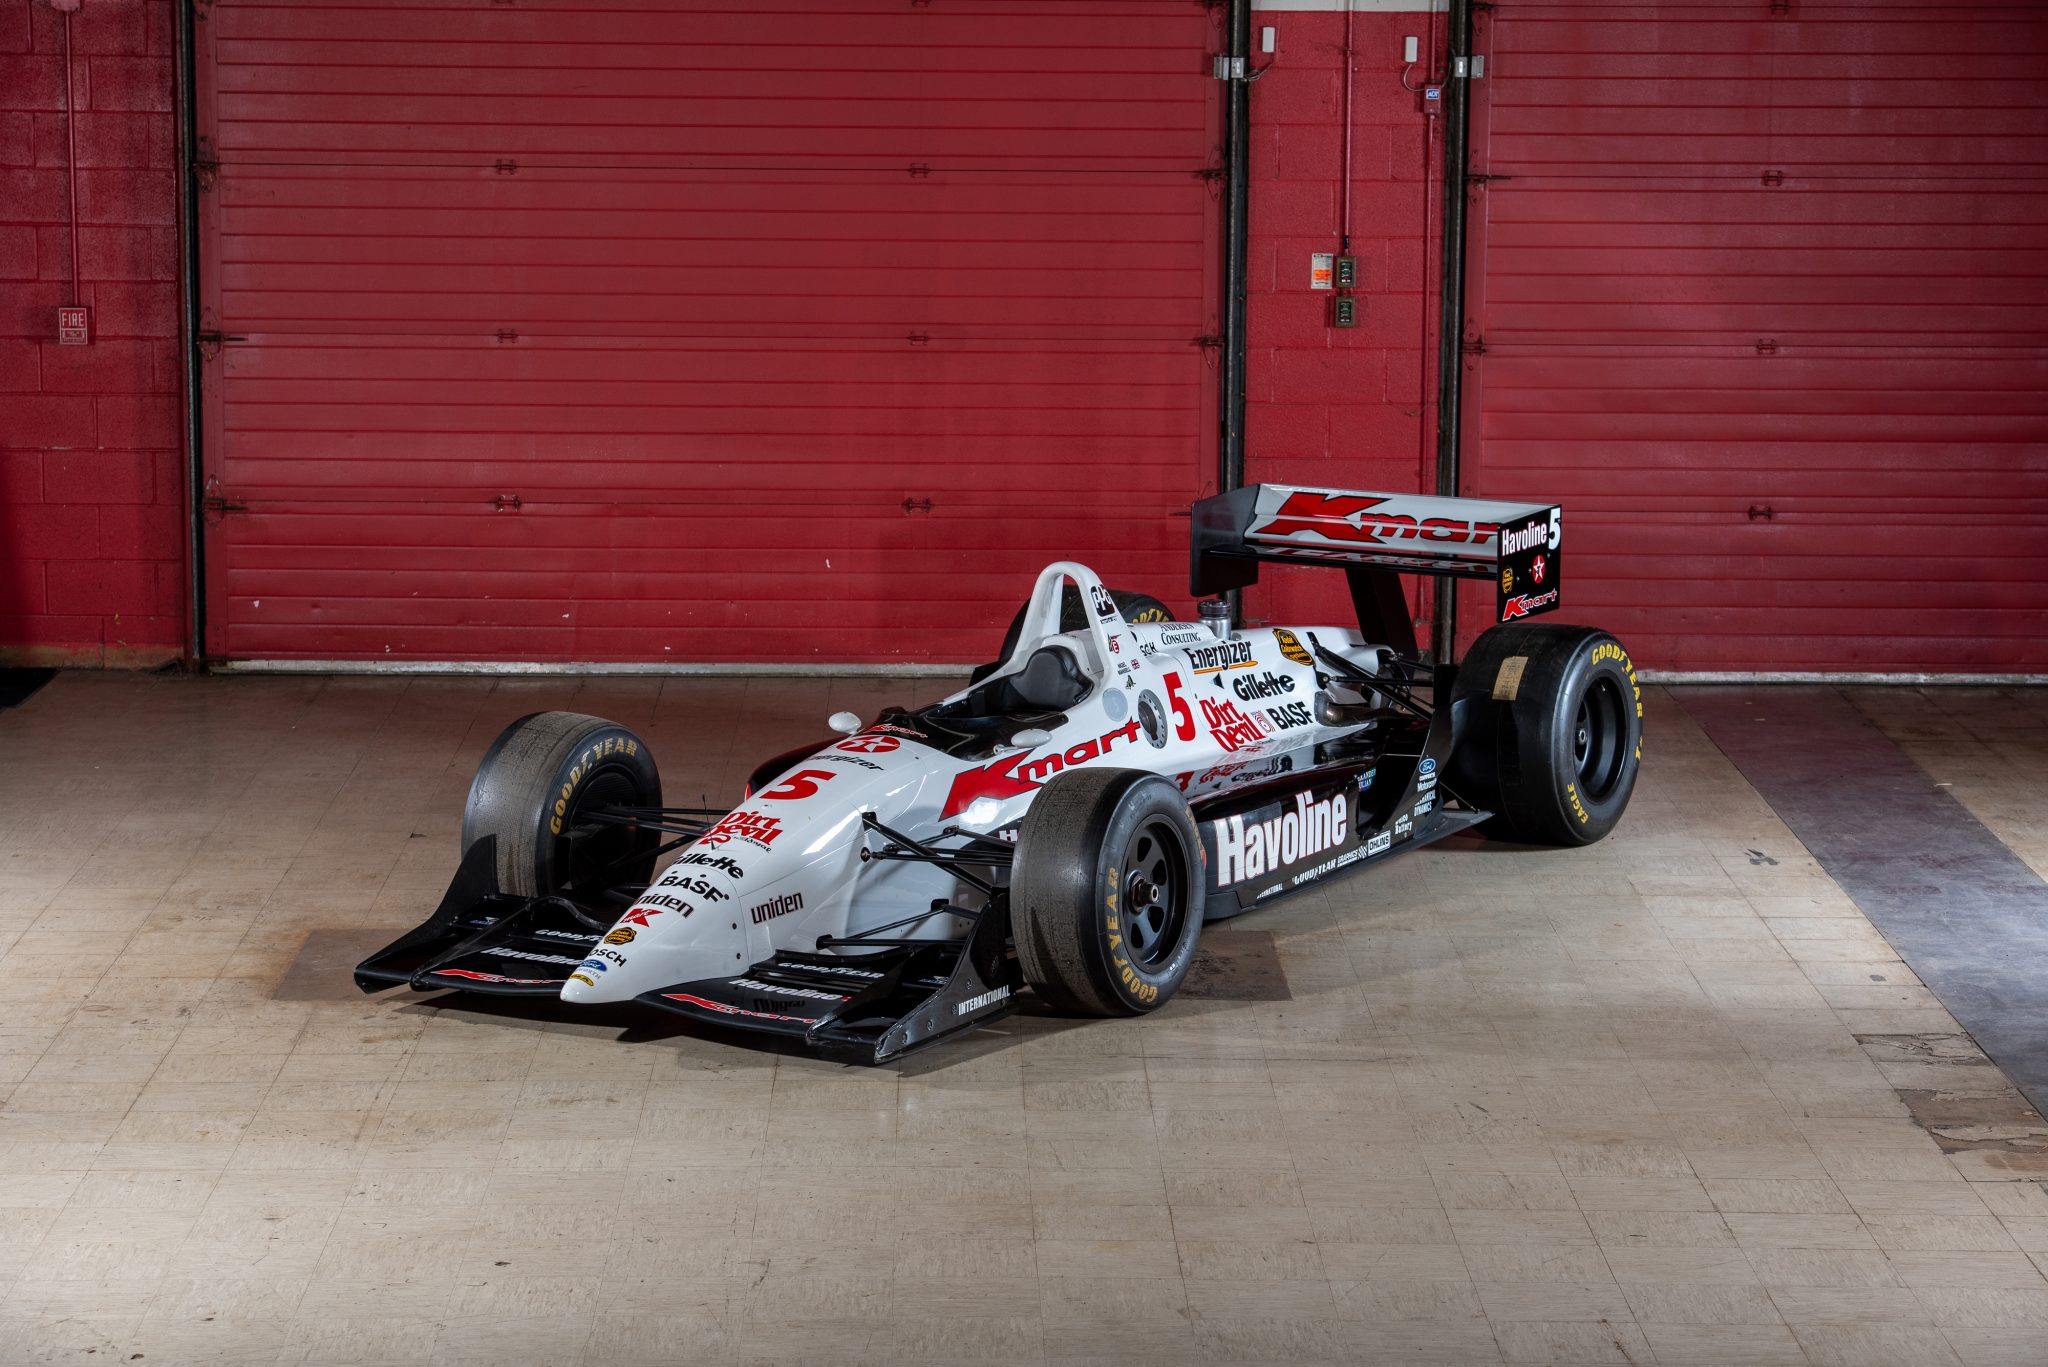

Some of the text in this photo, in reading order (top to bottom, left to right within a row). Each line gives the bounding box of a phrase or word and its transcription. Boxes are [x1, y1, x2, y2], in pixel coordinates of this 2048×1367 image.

[61, 312, 85, 327] FIRE
[1253, 491, 1499, 544] Kmar
[1502, 507, 1561, 556] Havoline 5
[1502, 588, 1558, 621] Kmart
[1182, 640, 1252, 670] Energizer
[1233, 671, 1296, 701] Gillette
[1592, 643, 1643, 718] GOODYEAR
[1163, 671, 1196, 741] 5
[1199, 696, 1243, 729] Dirt
[1266, 701, 1314, 729] BASF
[1210, 712, 1266, 752] Devil
[758, 769, 838, 800] 5
[938, 716, 1141, 822] Kmart
[550, 737, 638, 834] GOODYEAR
[1567, 782, 1589, 824] EAGLE
[702, 824, 784, 846] Devil
[721, 811, 784, 829] Dirt
[1213, 789, 1348, 887] Havoline
[675, 853, 744, 879] illette
[657, 876, 726, 902] BASF
[633, 894, 695, 919] niden
[751, 892, 804, 924] uniden
[1107, 867, 1158, 1003] GOODYEAR
[588, 948, 628, 967] OSCH
[958, 985, 1011, 1016] INTERNATIONAL
